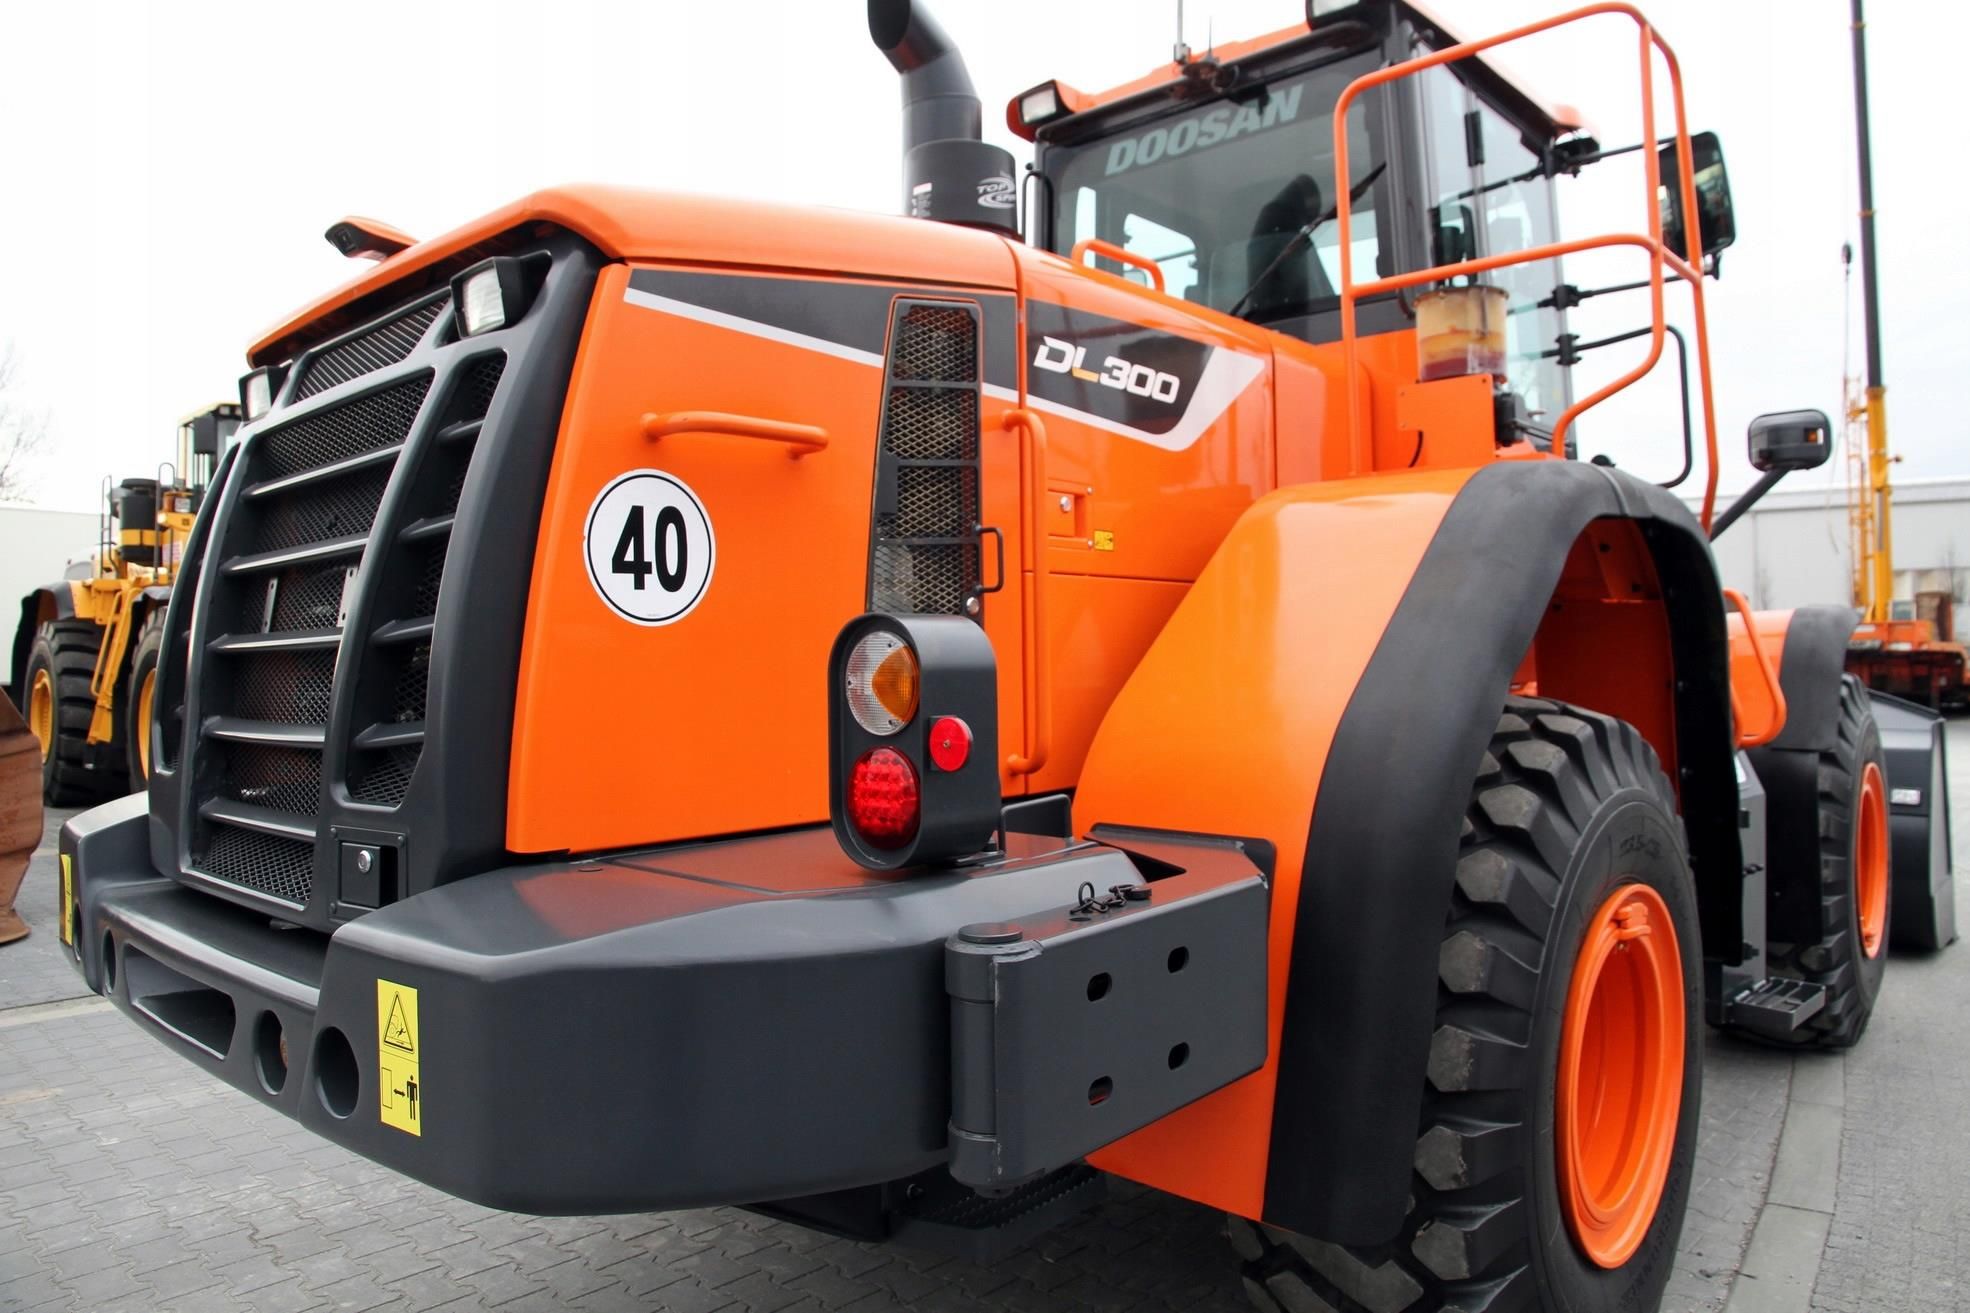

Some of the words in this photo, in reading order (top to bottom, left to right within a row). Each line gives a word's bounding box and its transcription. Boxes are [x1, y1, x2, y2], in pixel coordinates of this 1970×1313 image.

[1105, 84, 1304, 176] DOOSAN
[1033, 335, 1180, 404] DL300
[612, 505, 688, 592] 40
